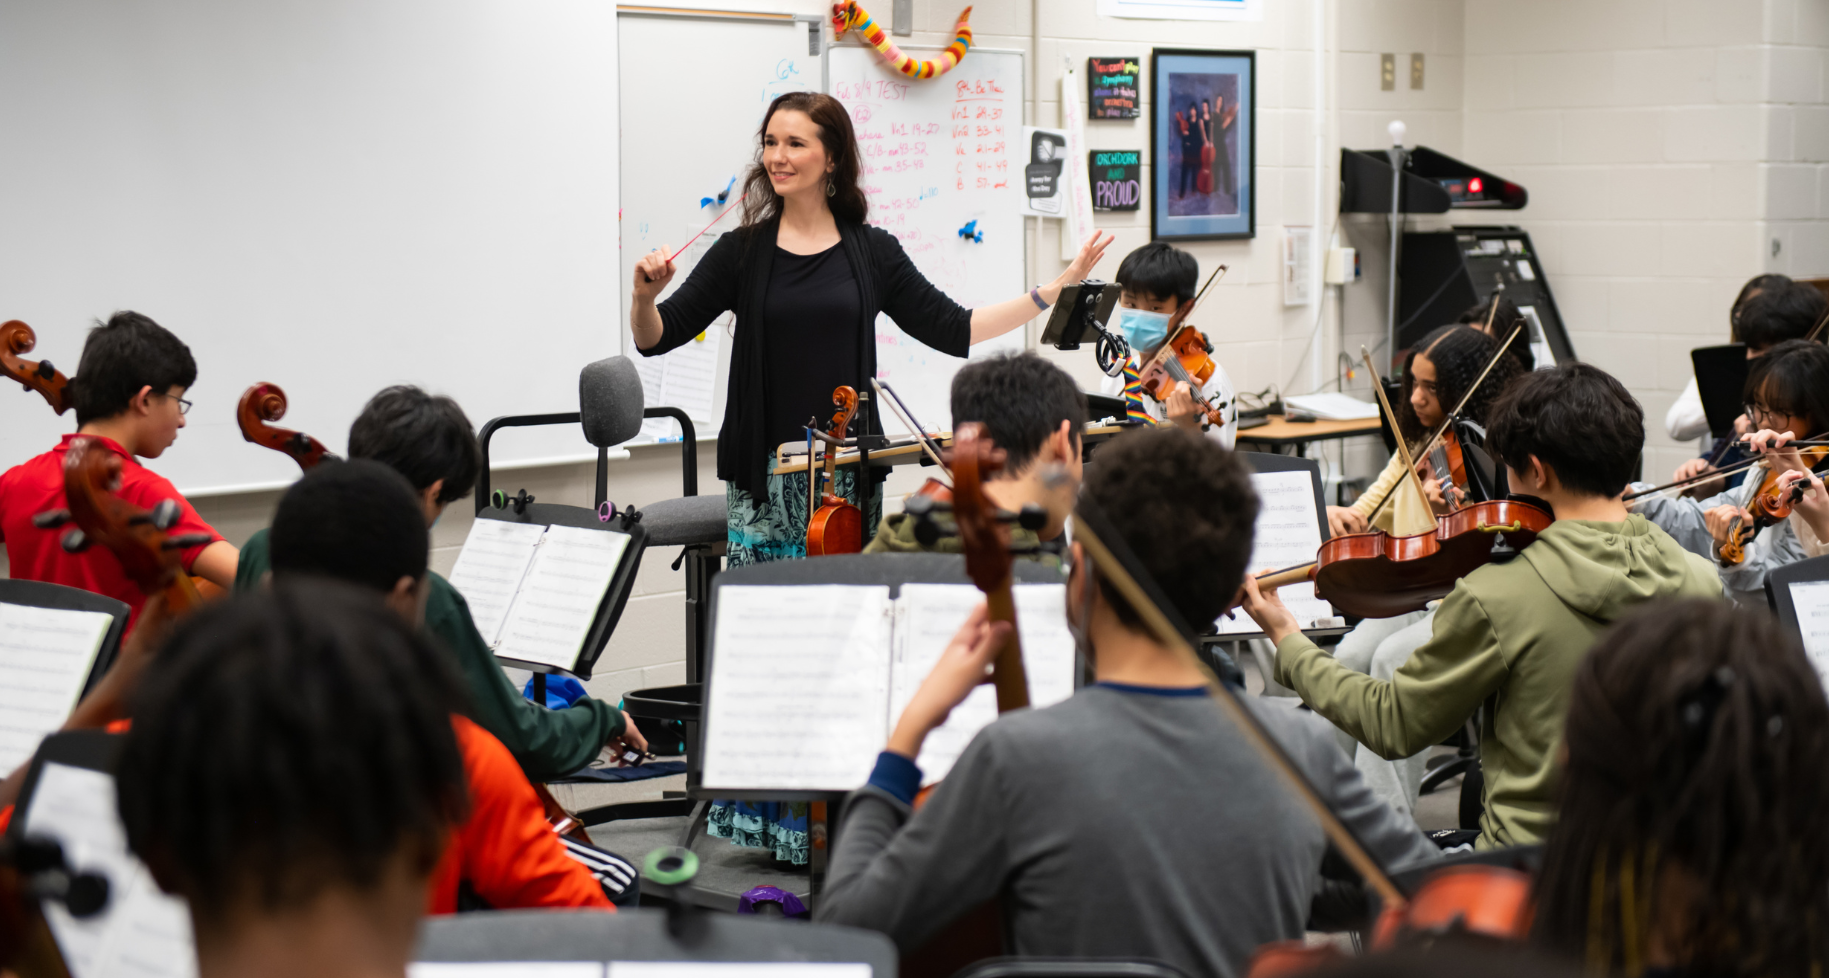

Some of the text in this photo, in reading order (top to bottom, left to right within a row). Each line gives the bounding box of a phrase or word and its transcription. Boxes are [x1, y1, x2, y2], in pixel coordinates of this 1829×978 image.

[876, 80, 911, 101] TEST
[1096, 152, 1139, 166] ORCHDORK
[1107, 167, 1125, 180] AND
[1096, 179, 1140, 207] PROUD
